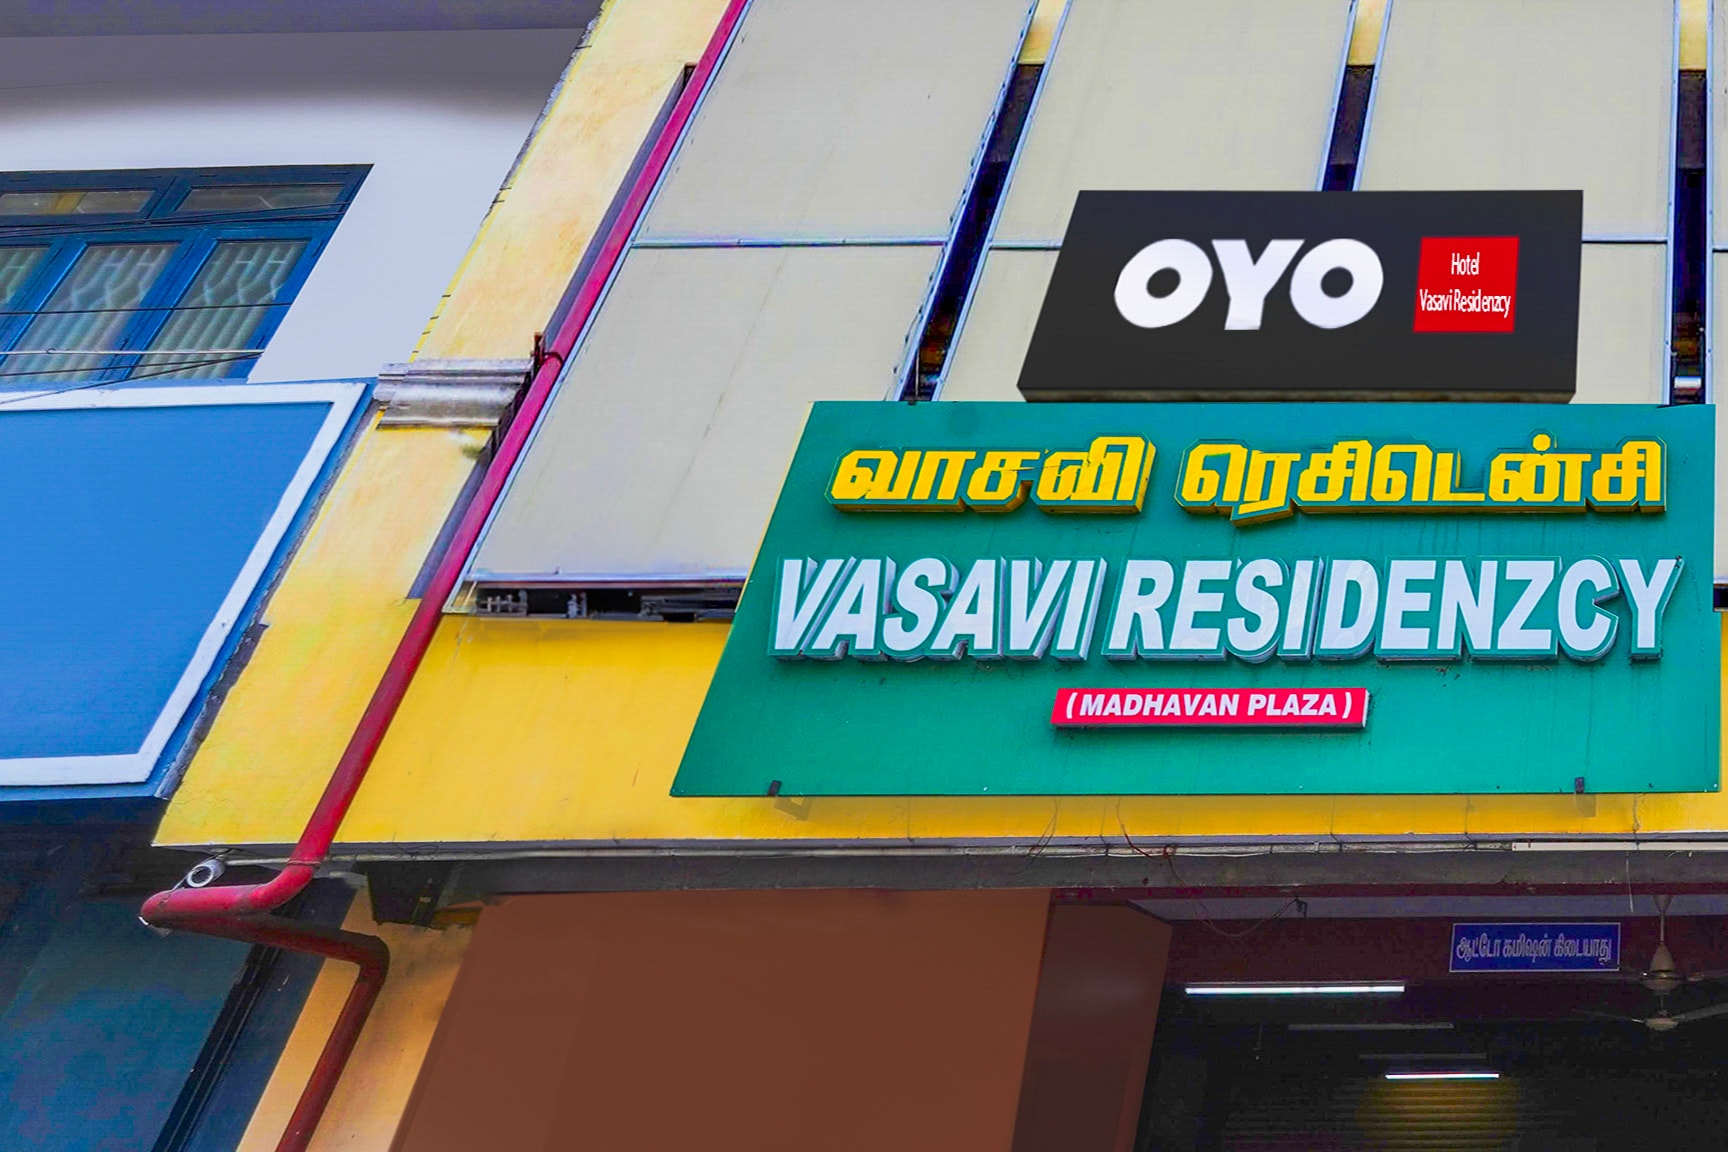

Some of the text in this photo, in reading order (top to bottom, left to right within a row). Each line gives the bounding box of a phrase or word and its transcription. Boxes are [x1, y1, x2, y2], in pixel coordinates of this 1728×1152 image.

[1114, 238, 1384, 330] OYO
[1451, 251, 1480, 276] Hotel
[1419, 288, 1512, 319] Vasavi Residenzcy
[829, 431, 1667, 518] வாசவி ரெசிடென்சி
[773, 556, 1682, 652] VASAVI RESIDENZCY
[1456, 932, 1612, 965] ஆட்டோ கமிஷன் கிடையாது
